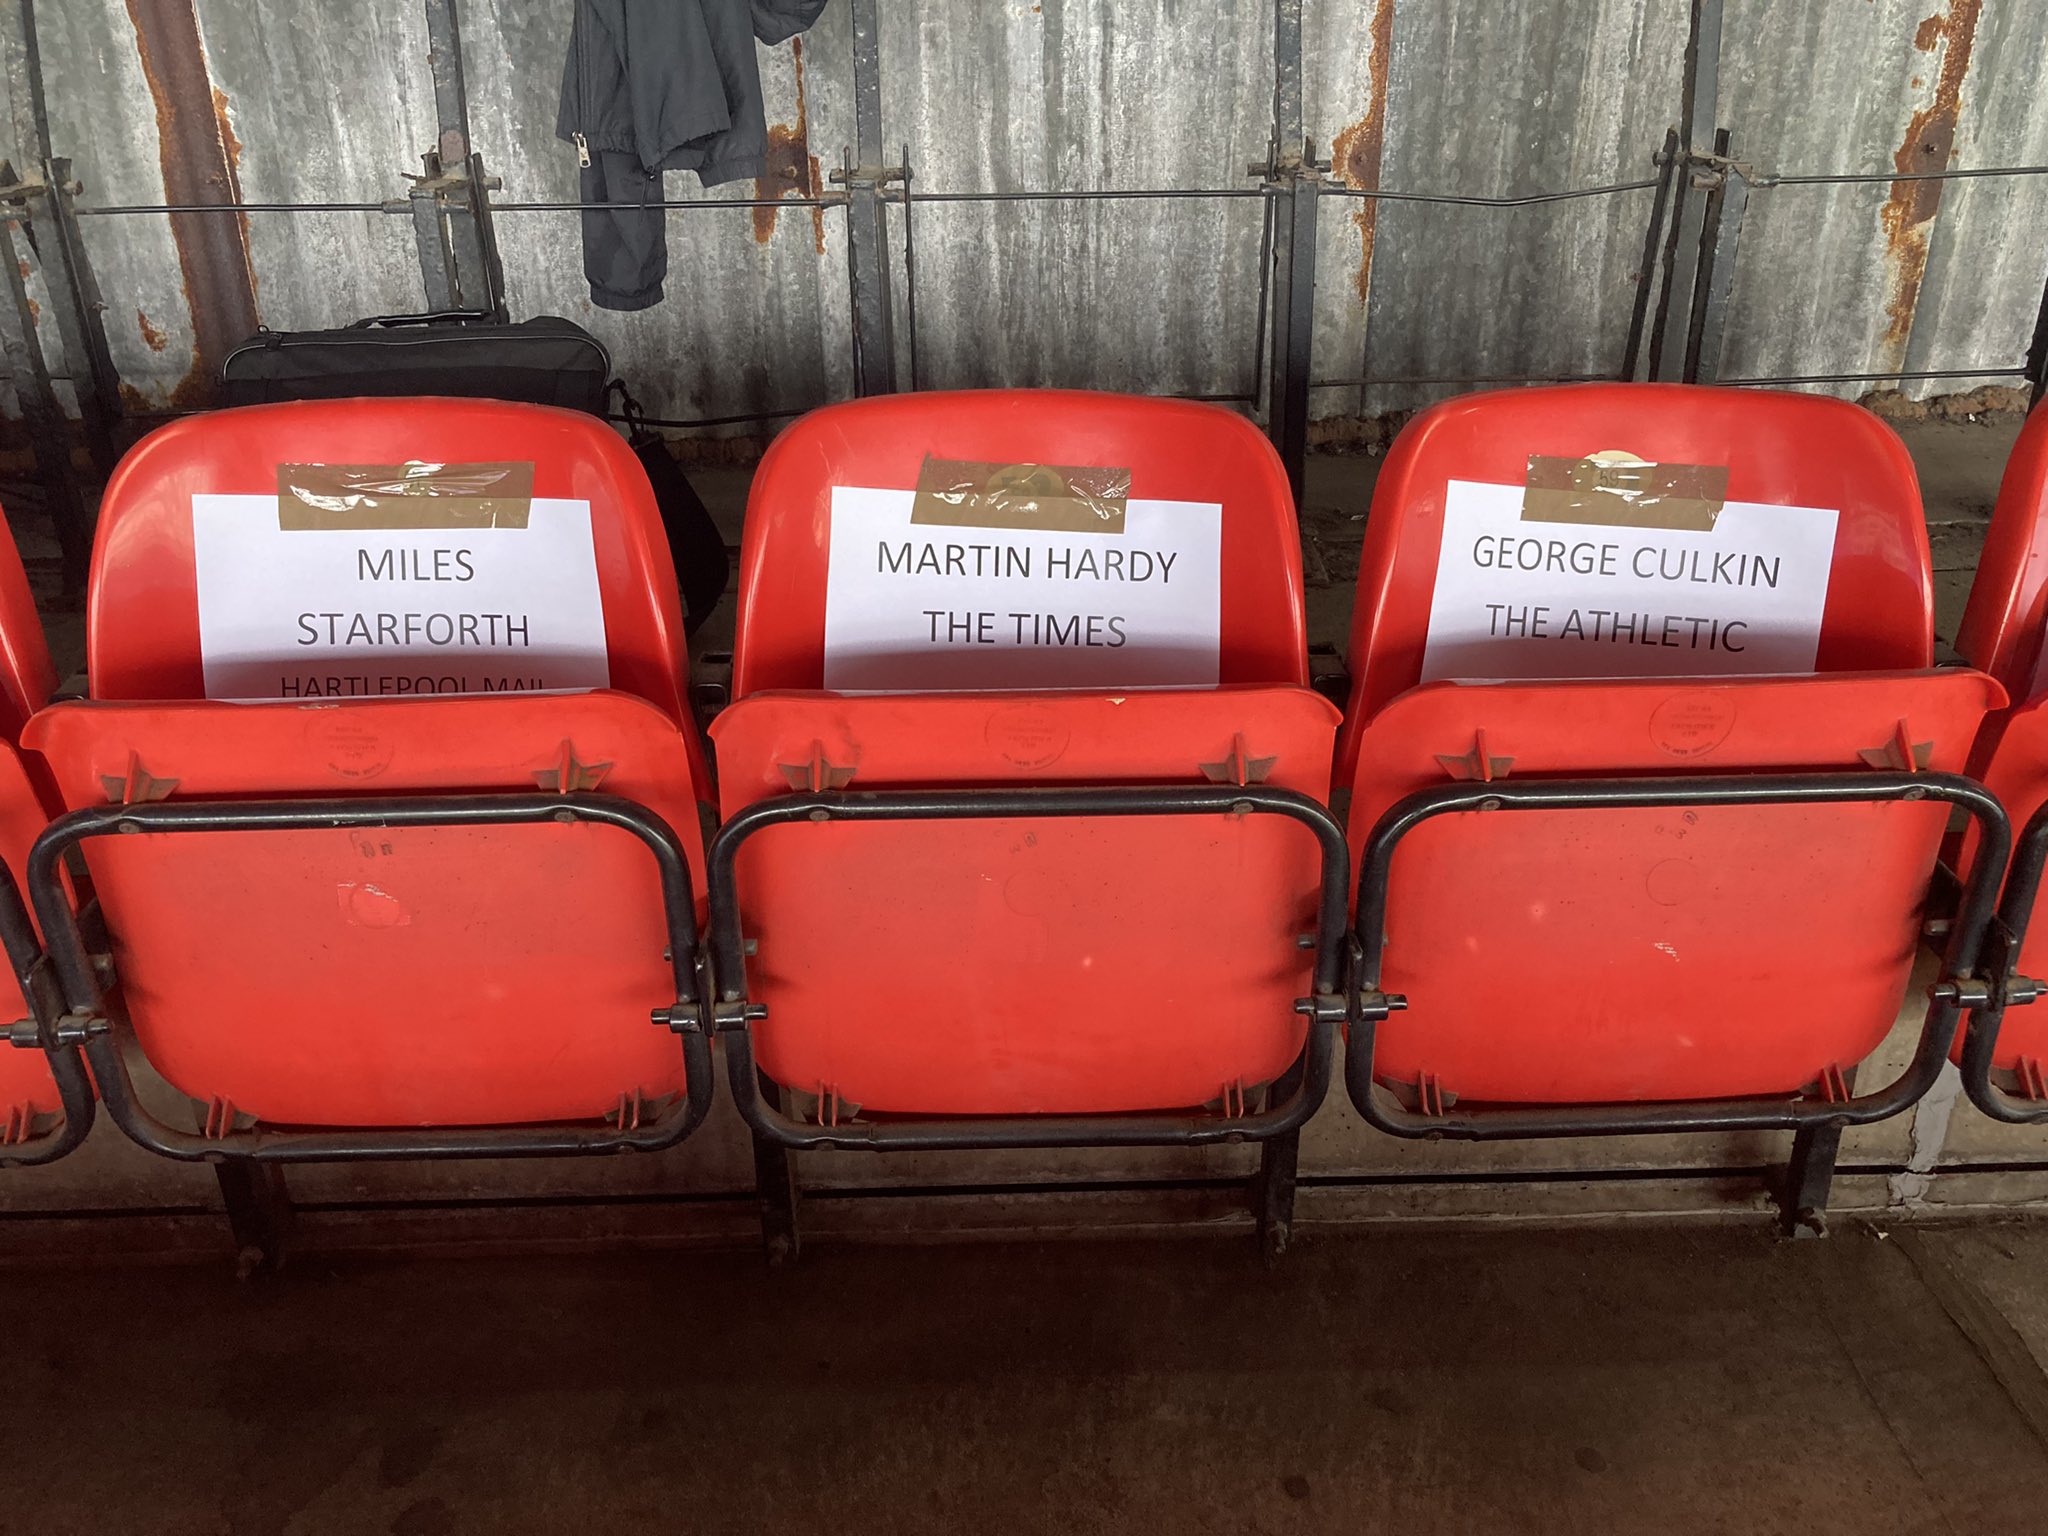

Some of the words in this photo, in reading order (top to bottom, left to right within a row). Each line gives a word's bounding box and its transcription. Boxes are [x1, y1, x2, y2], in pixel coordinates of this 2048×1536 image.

[358, 548, 475, 581] MILES
[877, 541, 1031, 578] MARTIN
[1047, 547, 1178, 583] HARDY
[1473, 535, 1620, 576] GEORGE
[1633, 546, 1781, 588] CULKIN
[297, 612, 529, 647] STARFORTH
[922, 610, 996, 644] THE
[1007, 613, 1127, 647] TIMES
[1485, 604, 1550, 638] THE
[1559, 608, 1748, 652] ATHLETIC
